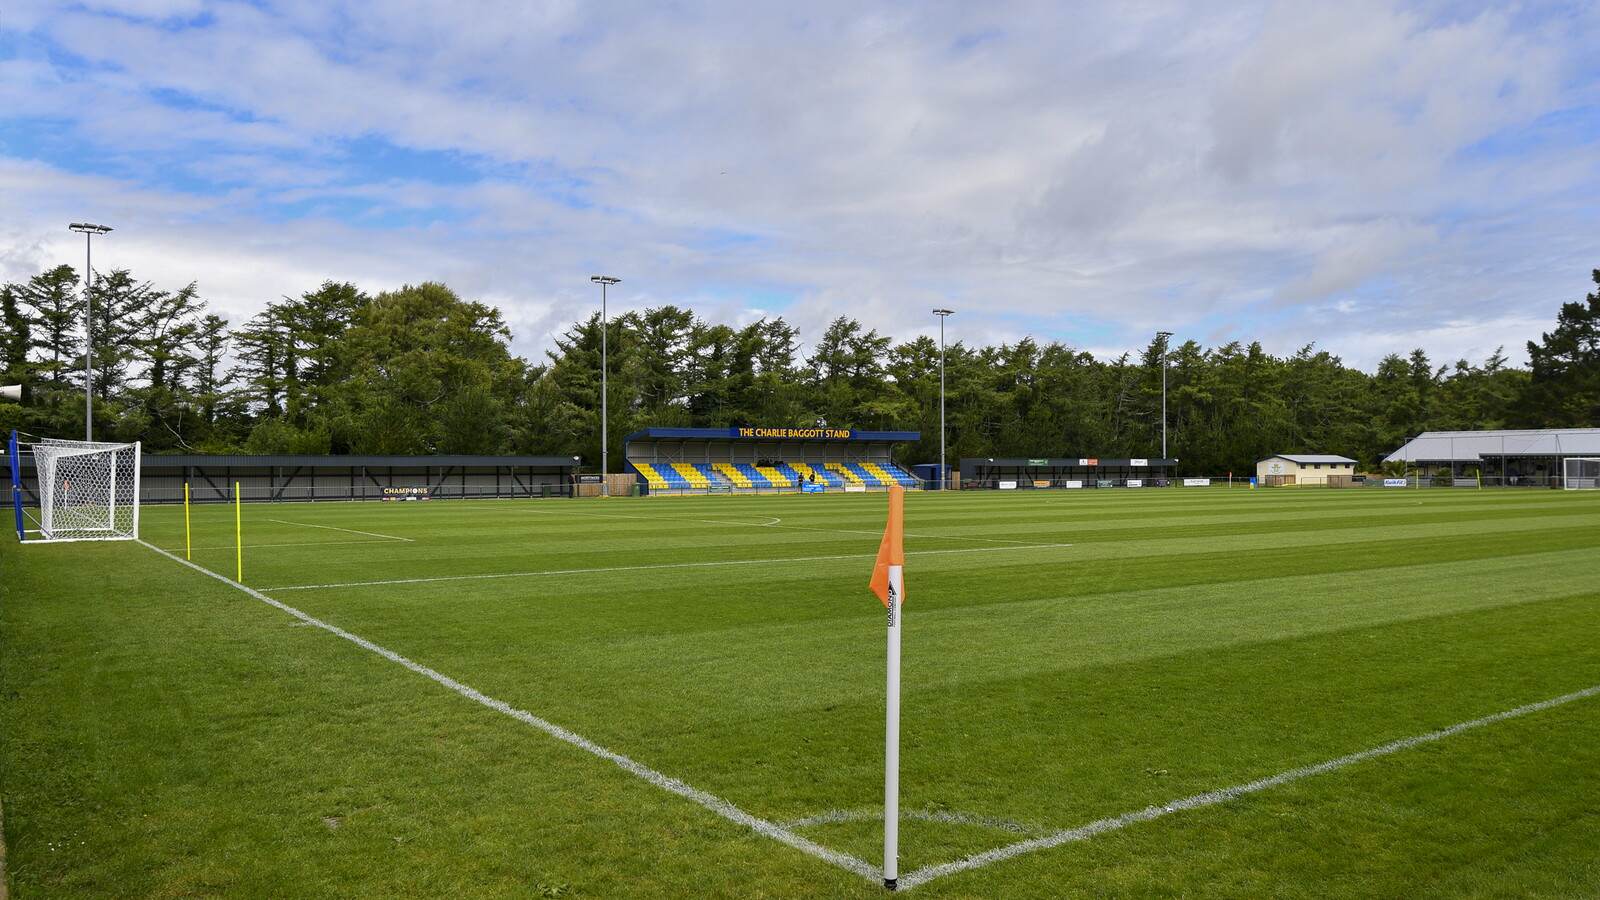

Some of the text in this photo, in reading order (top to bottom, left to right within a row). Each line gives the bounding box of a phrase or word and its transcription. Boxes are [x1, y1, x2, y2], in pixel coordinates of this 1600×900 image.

[739, 428, 850, 438] THE CHARLIE BAGGOTT STAND
